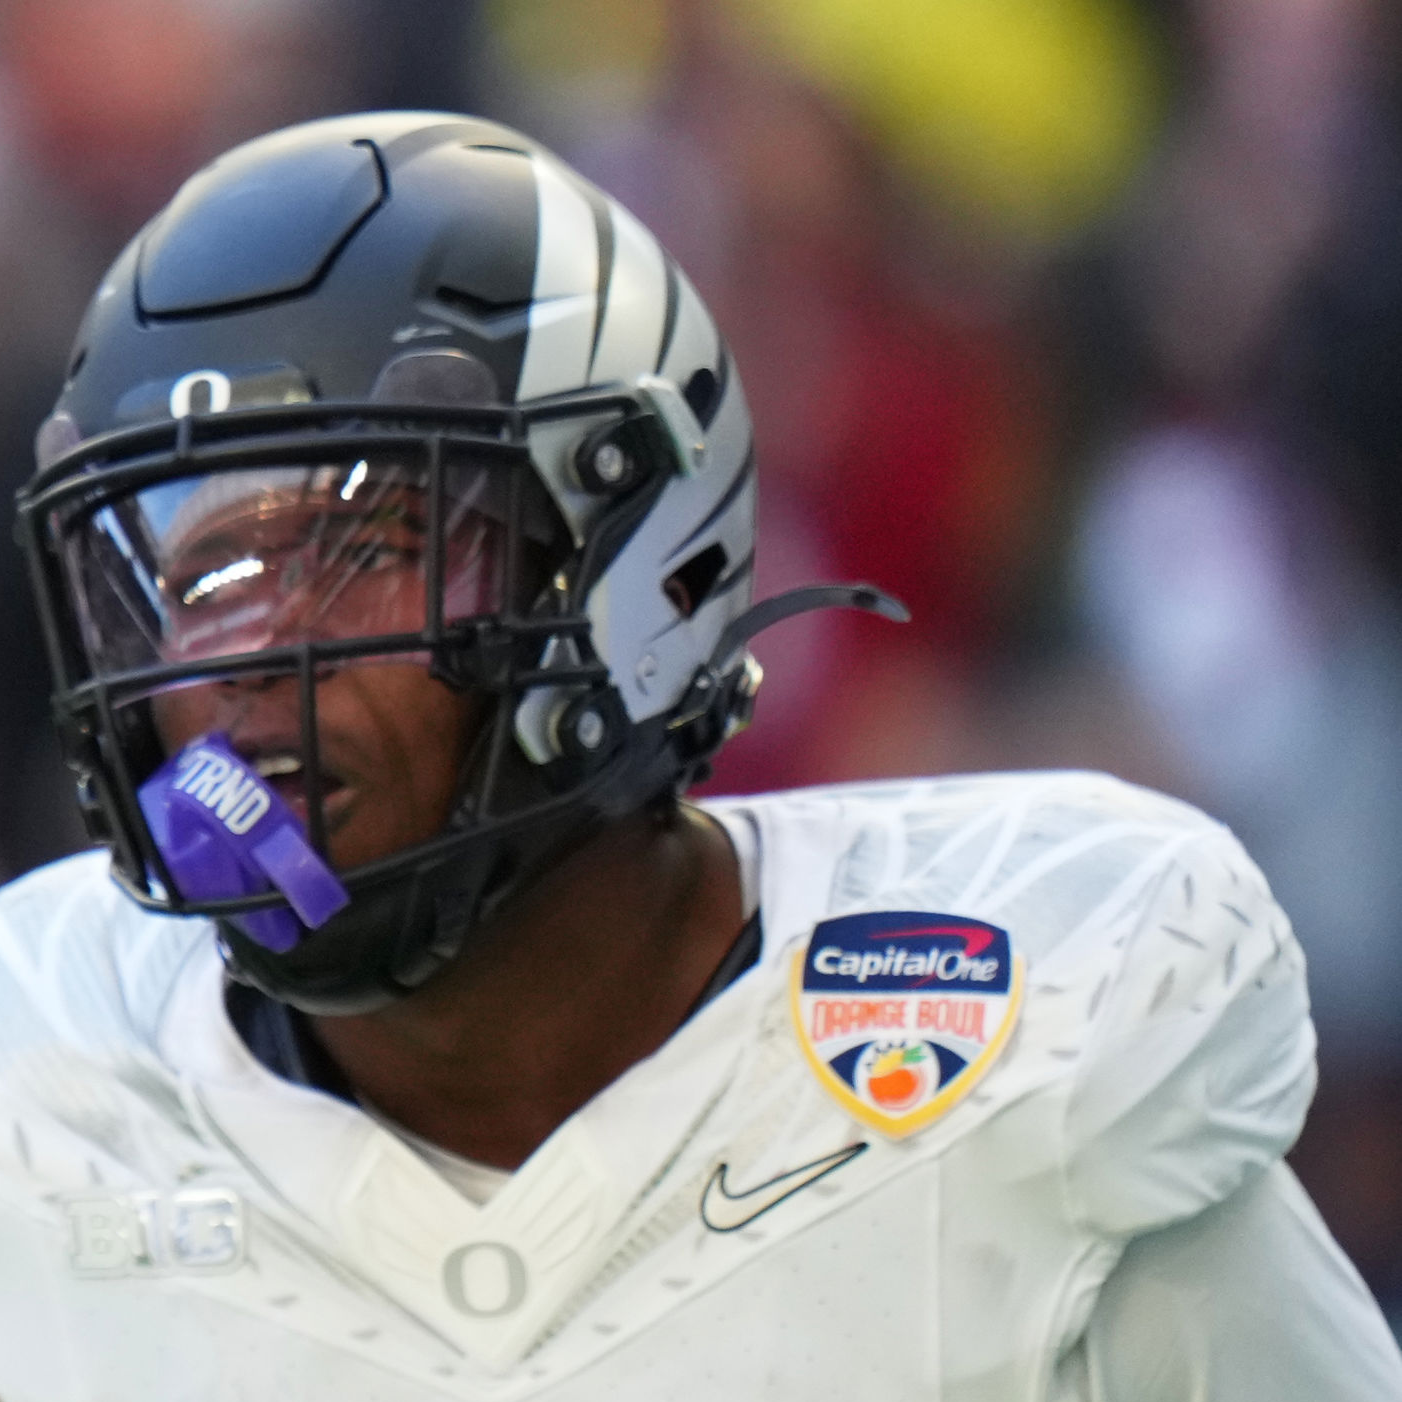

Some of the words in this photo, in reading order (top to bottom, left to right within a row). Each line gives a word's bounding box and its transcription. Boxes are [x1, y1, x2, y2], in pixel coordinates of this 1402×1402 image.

[812, 1000, 905, 1043] ORANGE
[916, 1000, 986, 1044] BOWL
[443, 1241, 529, 1319] O
